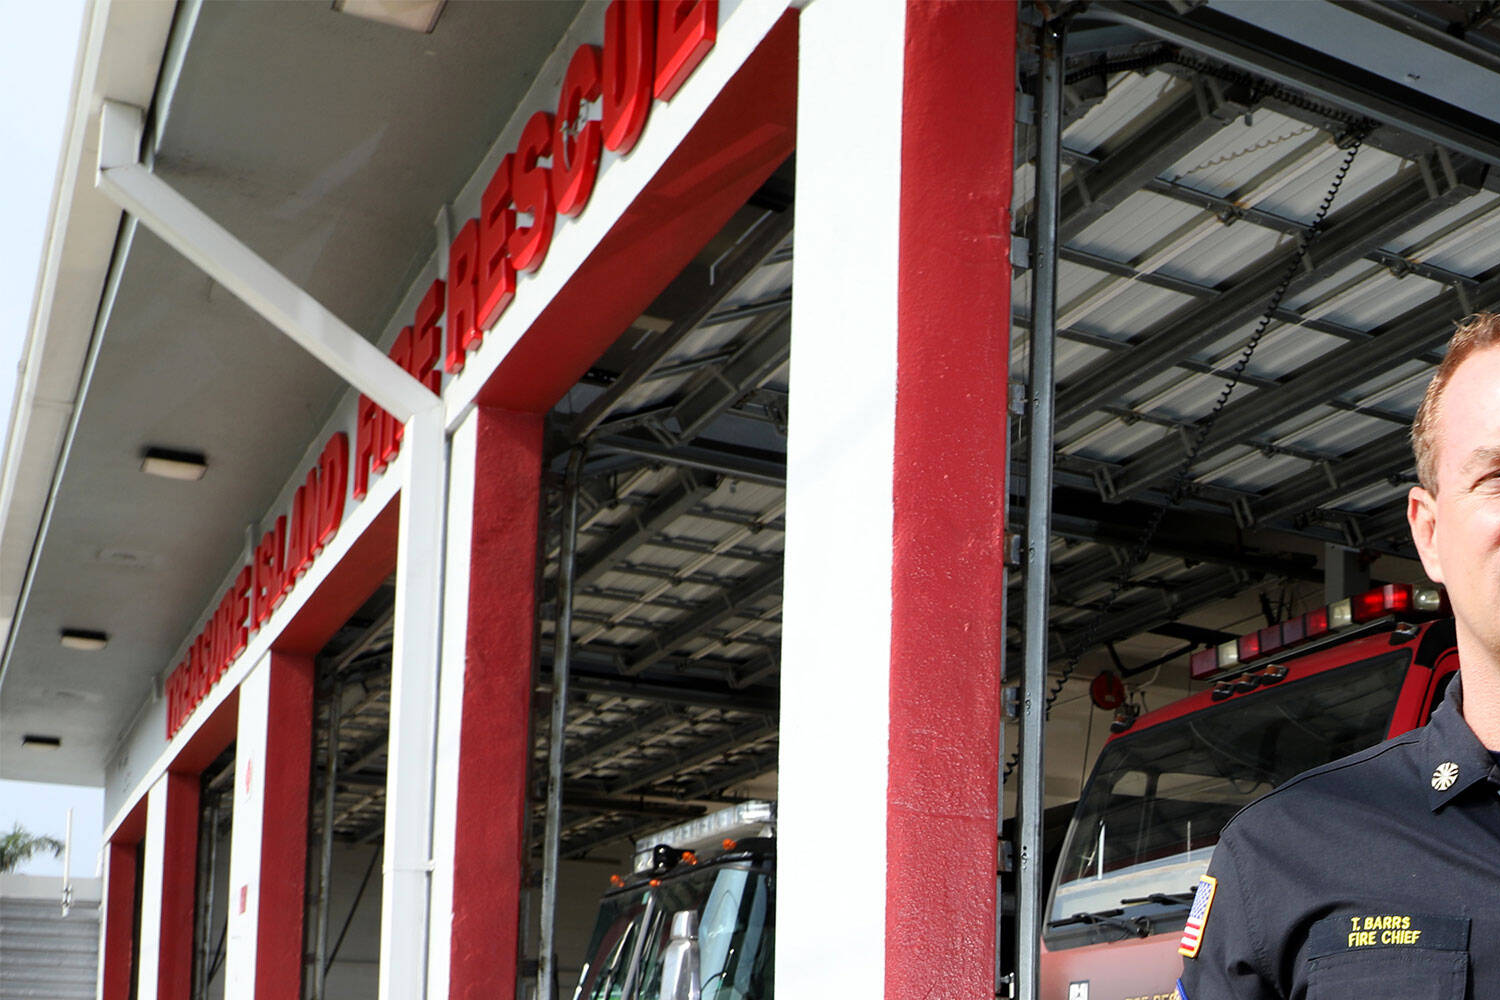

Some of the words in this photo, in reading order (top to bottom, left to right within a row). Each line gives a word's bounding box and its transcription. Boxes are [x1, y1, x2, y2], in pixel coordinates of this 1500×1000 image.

[165, 565, 252, 742] TREASURE
[251, 431, 349, 634] ISLAND
[1350, 917, 1361, 931] T.
[1364, 915, 1411, 930] BARRS
[1348, 931, 1377, 948] FIRE
[1381, 929, 1422, 945] CHIEF
